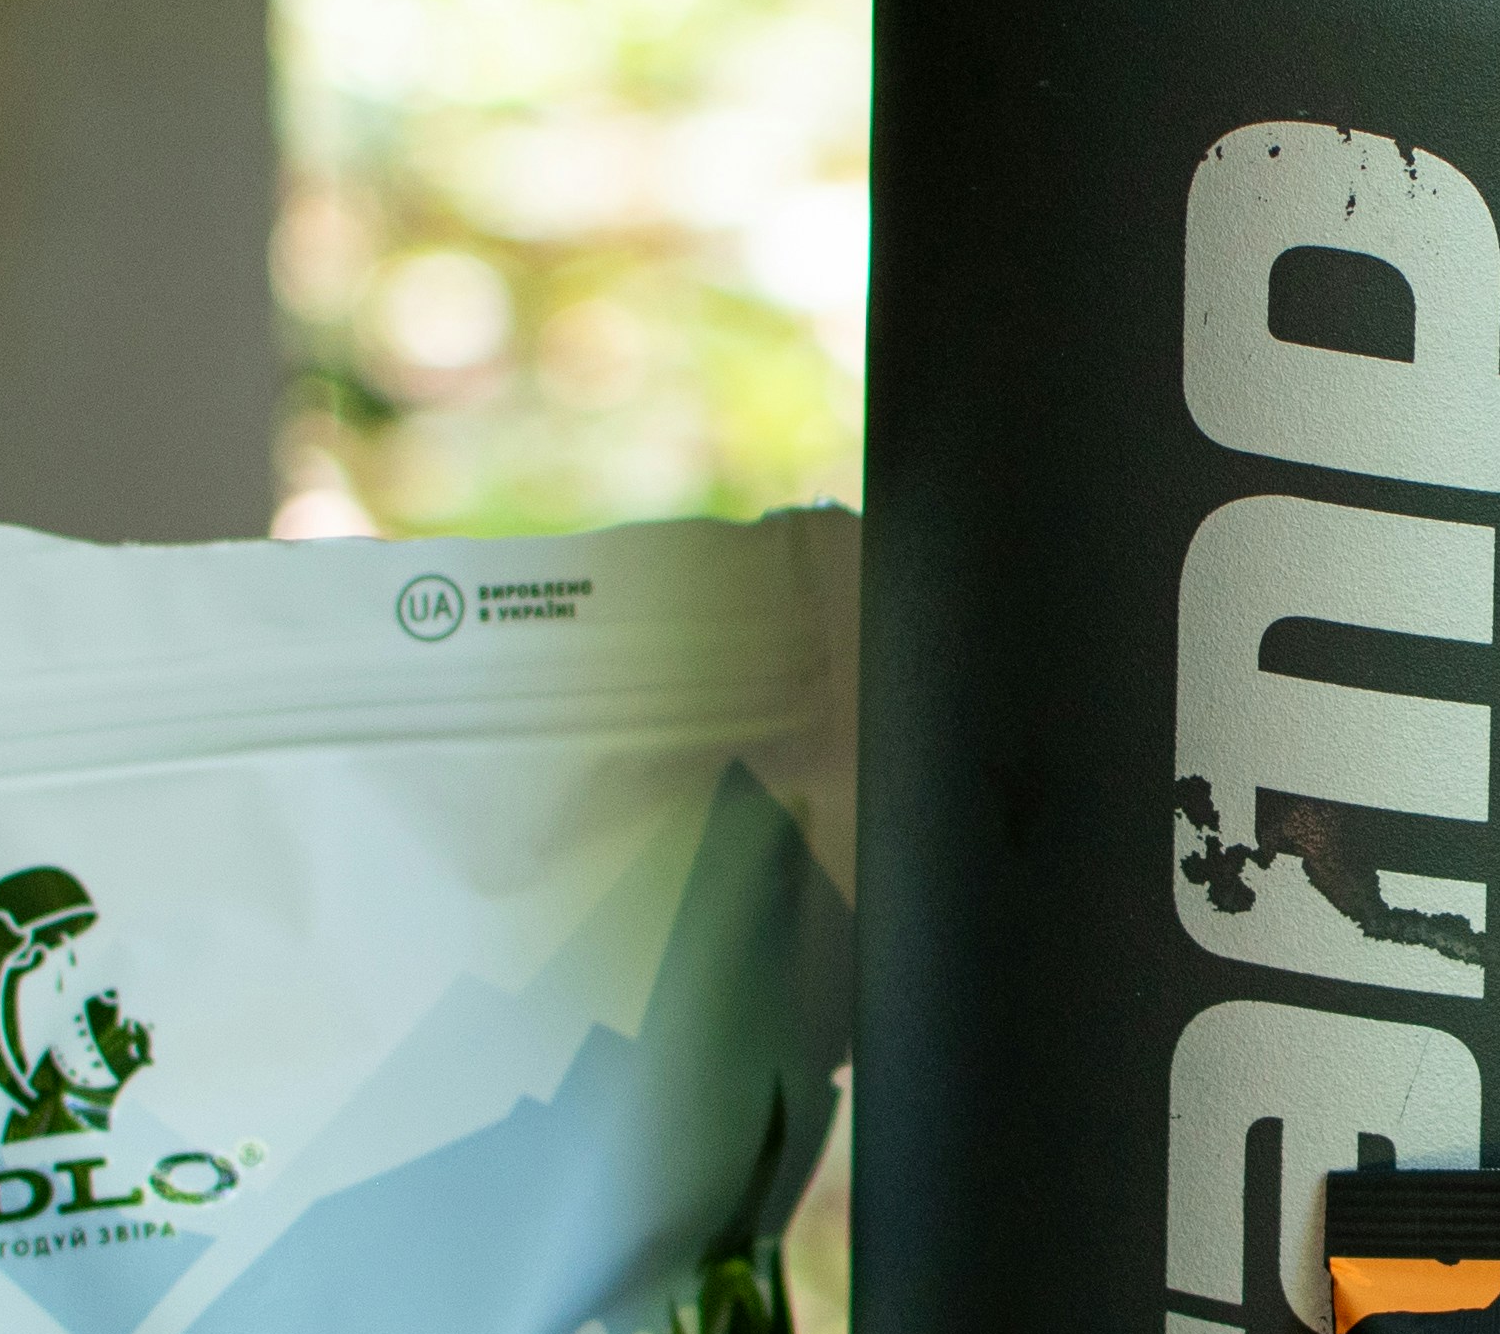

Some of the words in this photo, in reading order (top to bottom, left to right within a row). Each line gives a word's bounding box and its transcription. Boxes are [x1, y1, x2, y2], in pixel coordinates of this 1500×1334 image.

[478, 578, 594, 601] ВИРОБЛЕНО
[407, 590, 453, 623] UA
[478, 605, 490, 622] В
[498, 599, 577, 621] УКРАЇНІ
[98, 1220, 177, 1246] ЗВІРА
